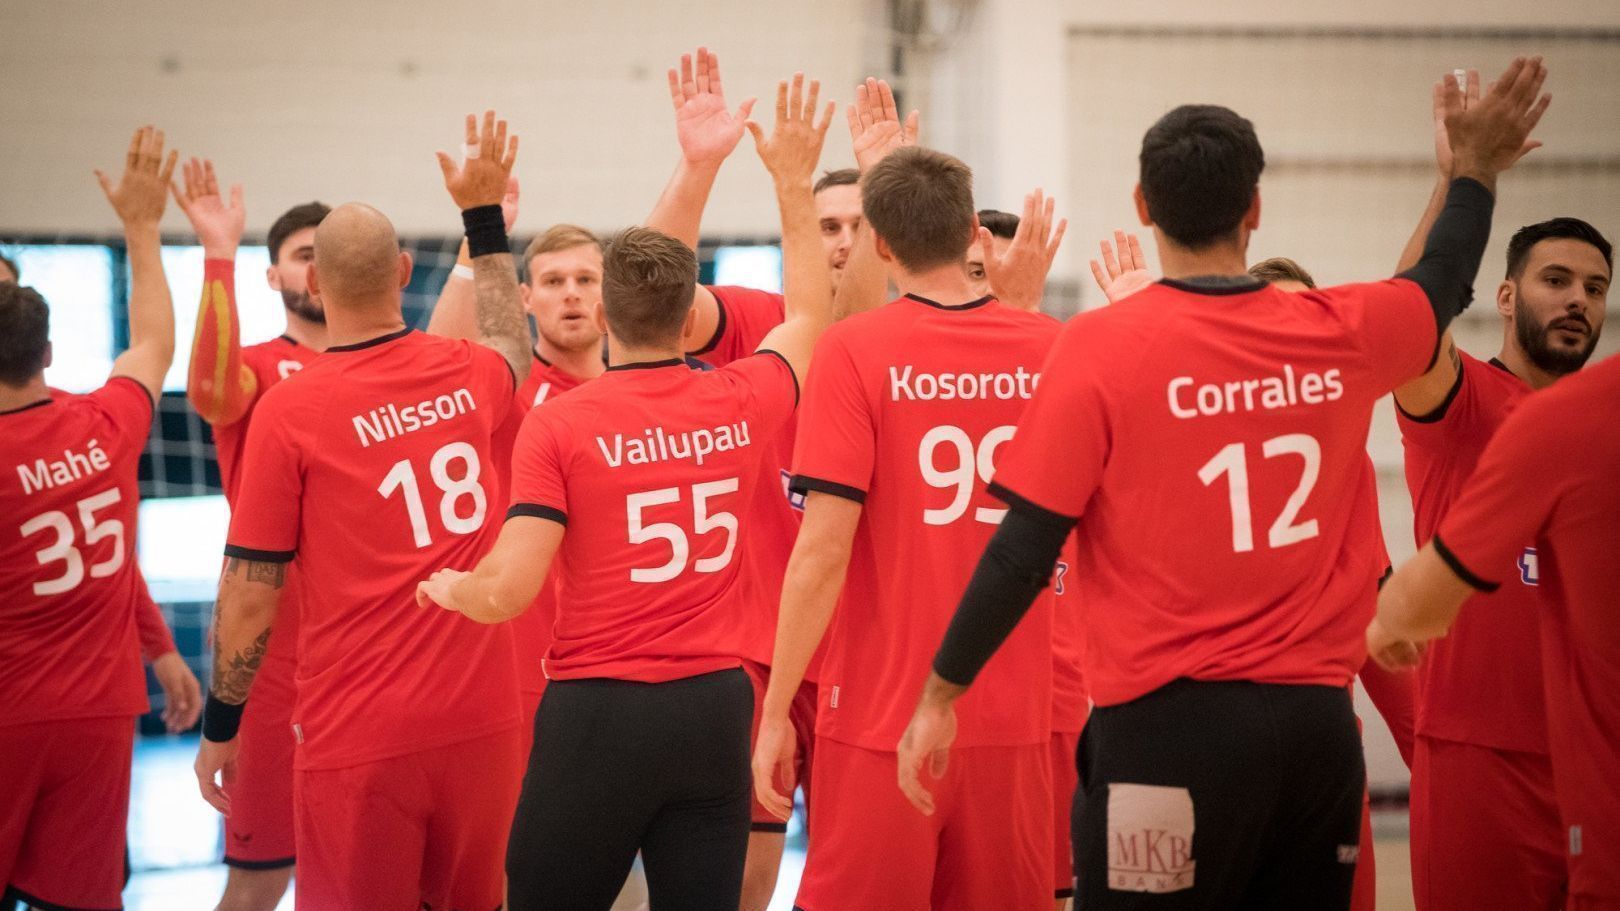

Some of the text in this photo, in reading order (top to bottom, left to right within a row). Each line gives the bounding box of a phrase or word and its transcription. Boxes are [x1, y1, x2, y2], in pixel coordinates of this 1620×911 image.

[889, 365, 1041, 401] Kosorot
[1168, 364, 1343, 419] Corrales
[352, 386, 476, 448] Nilsson
[596, 421, 751, 468] Vailupau
[17, 440, 111, 494] Mahé
[376, 442, 487, 548] 18
[1198, 433, 1321, 553] 12
[20, 487, 124, 597] 35
[626, 478, 739, 584] 55
[1116, 828, 1190, 874] MKB
